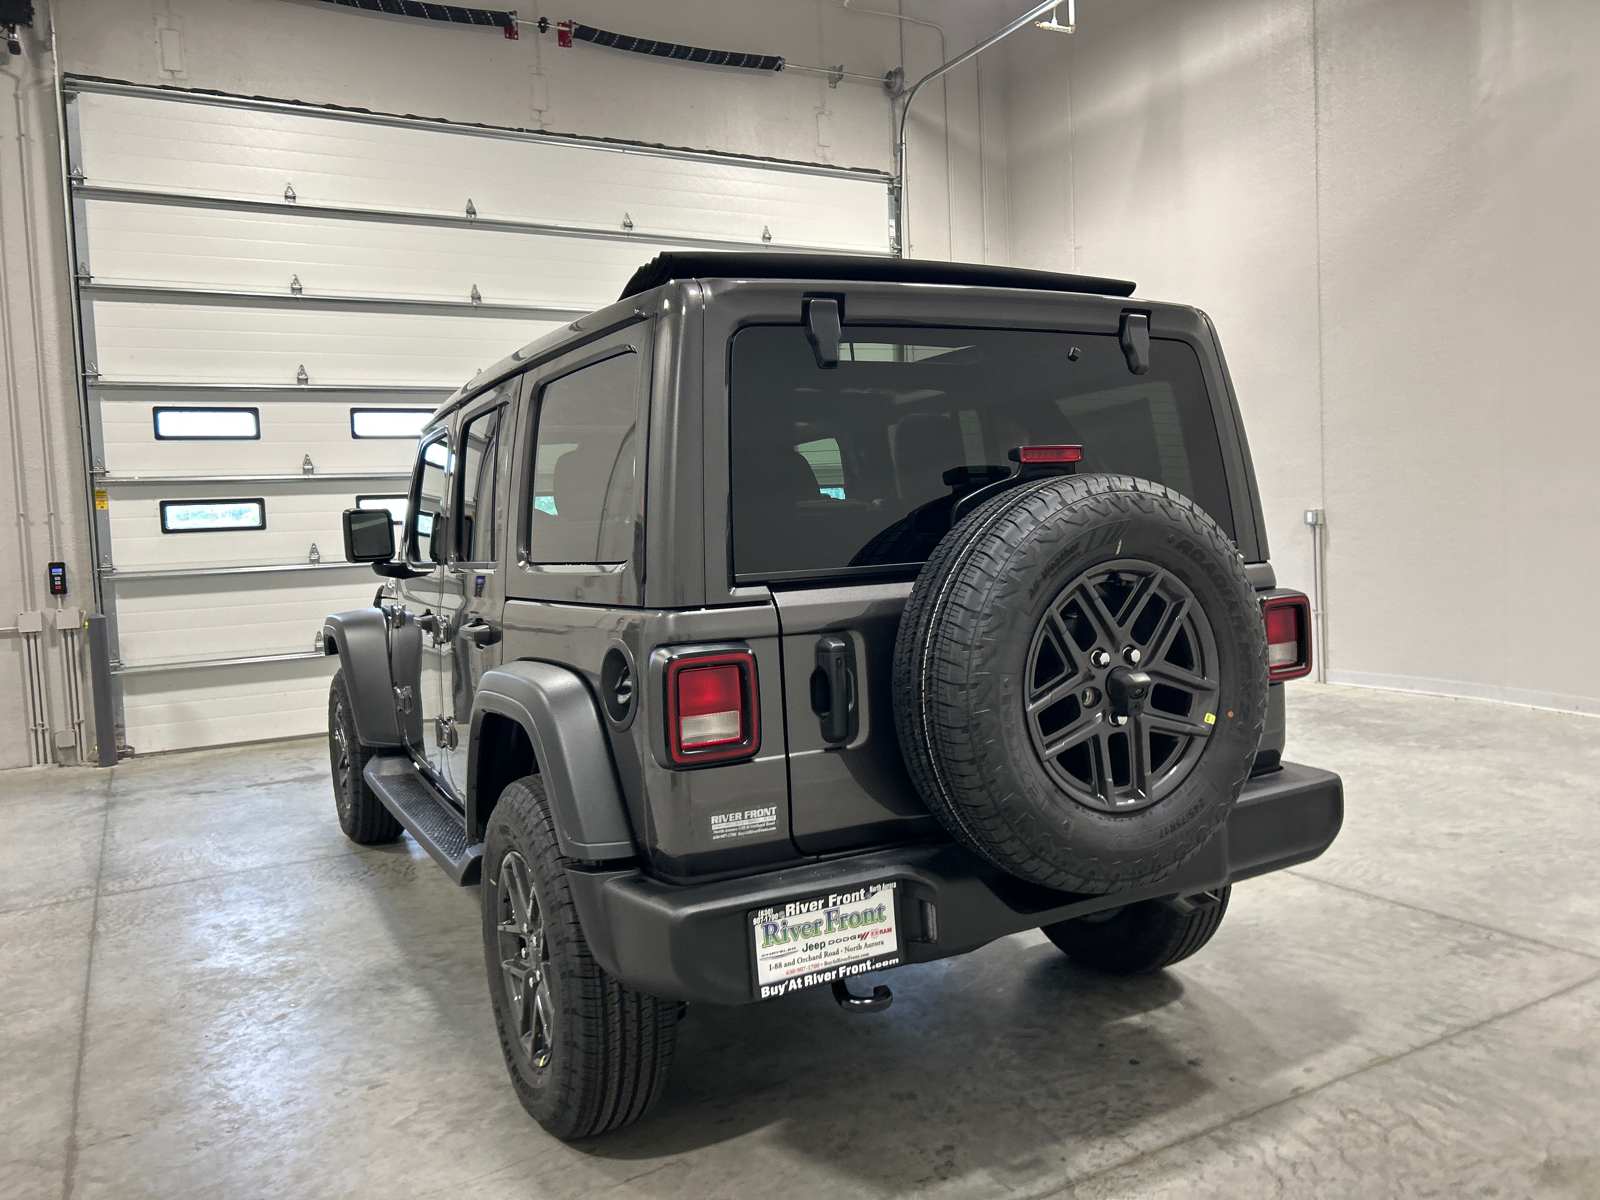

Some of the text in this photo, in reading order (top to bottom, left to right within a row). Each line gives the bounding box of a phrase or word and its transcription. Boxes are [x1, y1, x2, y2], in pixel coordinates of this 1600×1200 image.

[1028, 542, 1081, 601] All-Weather
[711, 812, 742, 824] RIVER
[744, 806, 777, 819] FRONT
[1158, 797, 1206, 840] 245/75R17
[785, 888, 866, 918] River Front
[761, 903, 887, 948] River Front
[828, 933, 863, 946] DODGE
[879, 927, 893, 935] RAM
[769, 940, 885, 971] I-88 and Orchard Road North Aurora
[802, 941, 826, 953] Jeep
[761, 983, 786, 998] Buy
[788, 978, 802, 991] At
[804, 970, 837, 987] River
